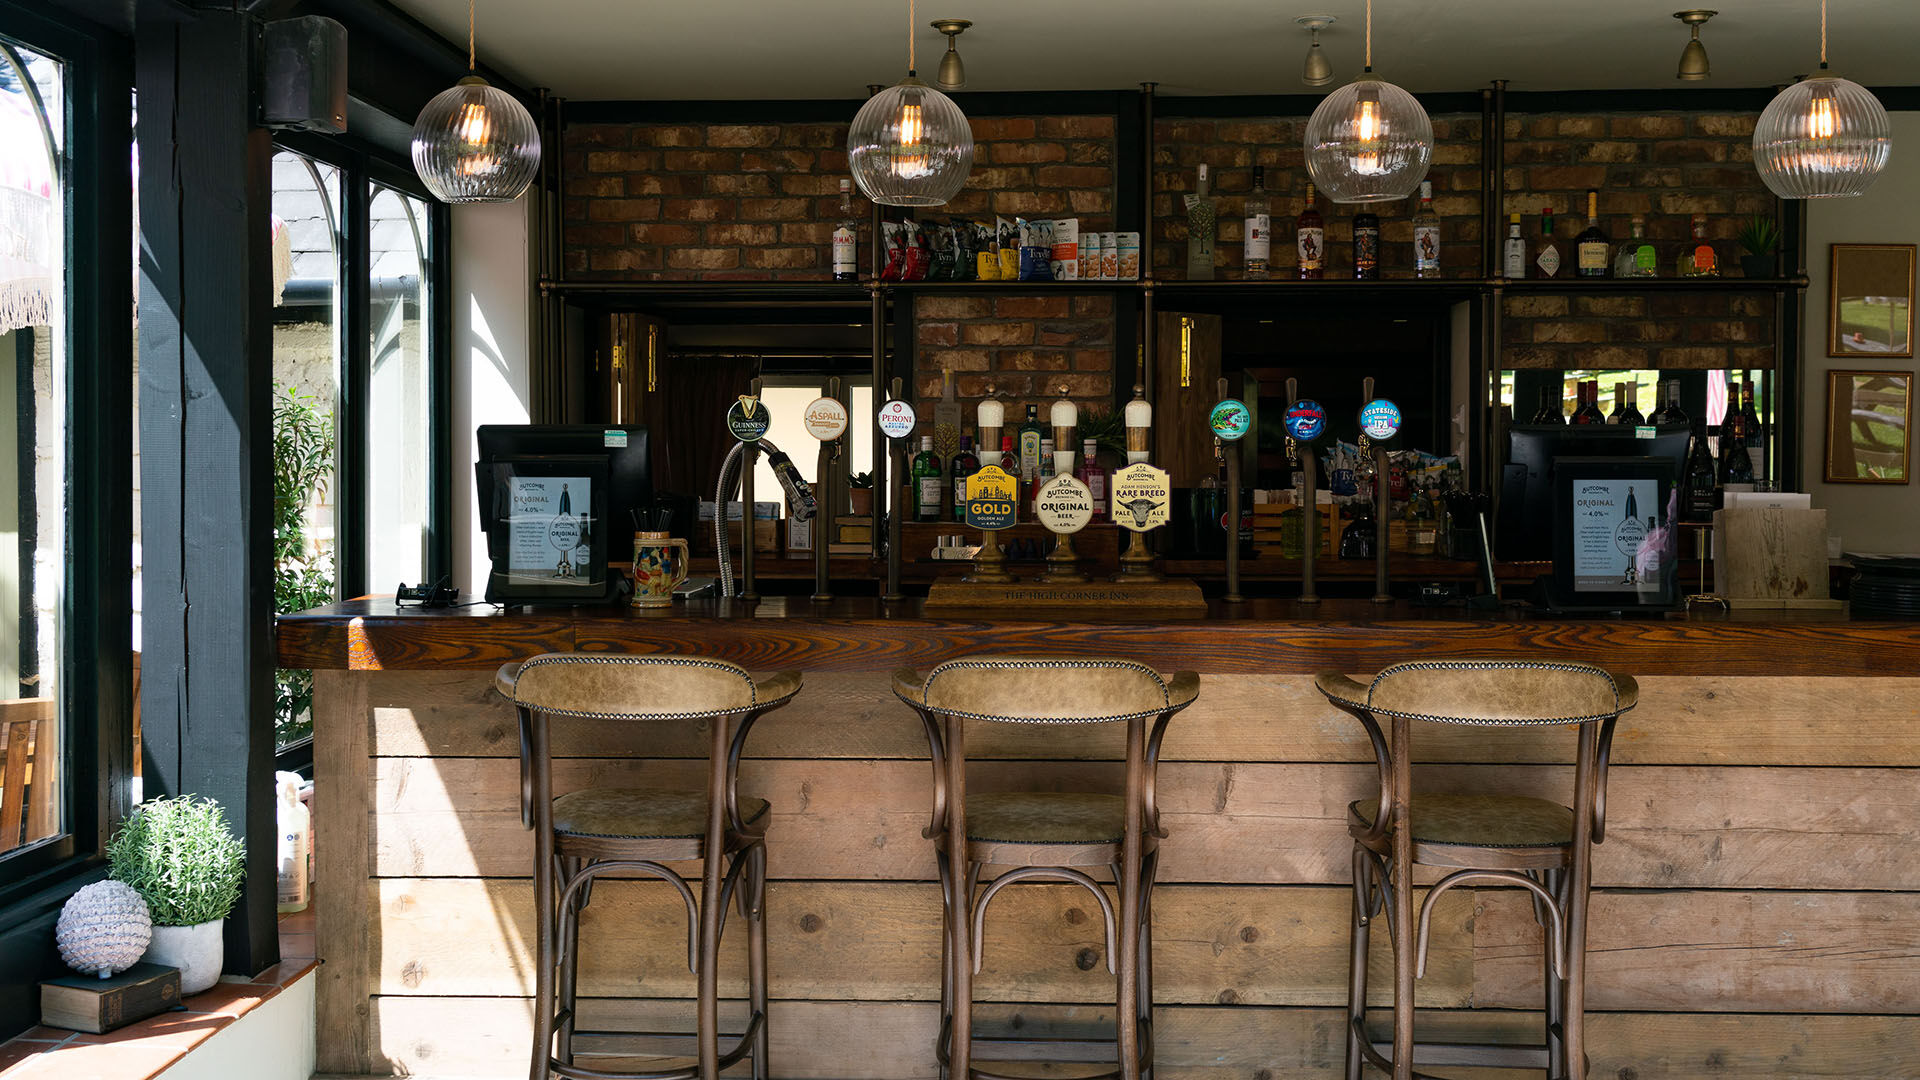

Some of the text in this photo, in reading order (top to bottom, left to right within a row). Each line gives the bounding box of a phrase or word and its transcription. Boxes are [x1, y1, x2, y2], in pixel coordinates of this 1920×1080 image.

[809, 410, 842, 421] ASPALL
[1364, 407, 1398, 417] STATESIDE
[882, 414, 912, 423] PERONI
[732, 421, 767, 429] GUINNESS
[1374, 420, 1388, 429] IPA
[977, 475, 1006, 483] BUTCOMBE
[1126, 473, 1156, 481] BUTCOMBE
[1047, 489, 1084, 498] BUTCOMBE
[1116, 490, 1166, 498] RARE BREED
[514, 496, 549, 504] ORIGINAL
[1577, 500, 1614, 508] ORIGINAL
[971, 503, 1011, 515] GOLD
[1041, 503, 1090, 513] ORIGINAL
[1005, 592, 1129, 600] THE HIGH CORNER INN
